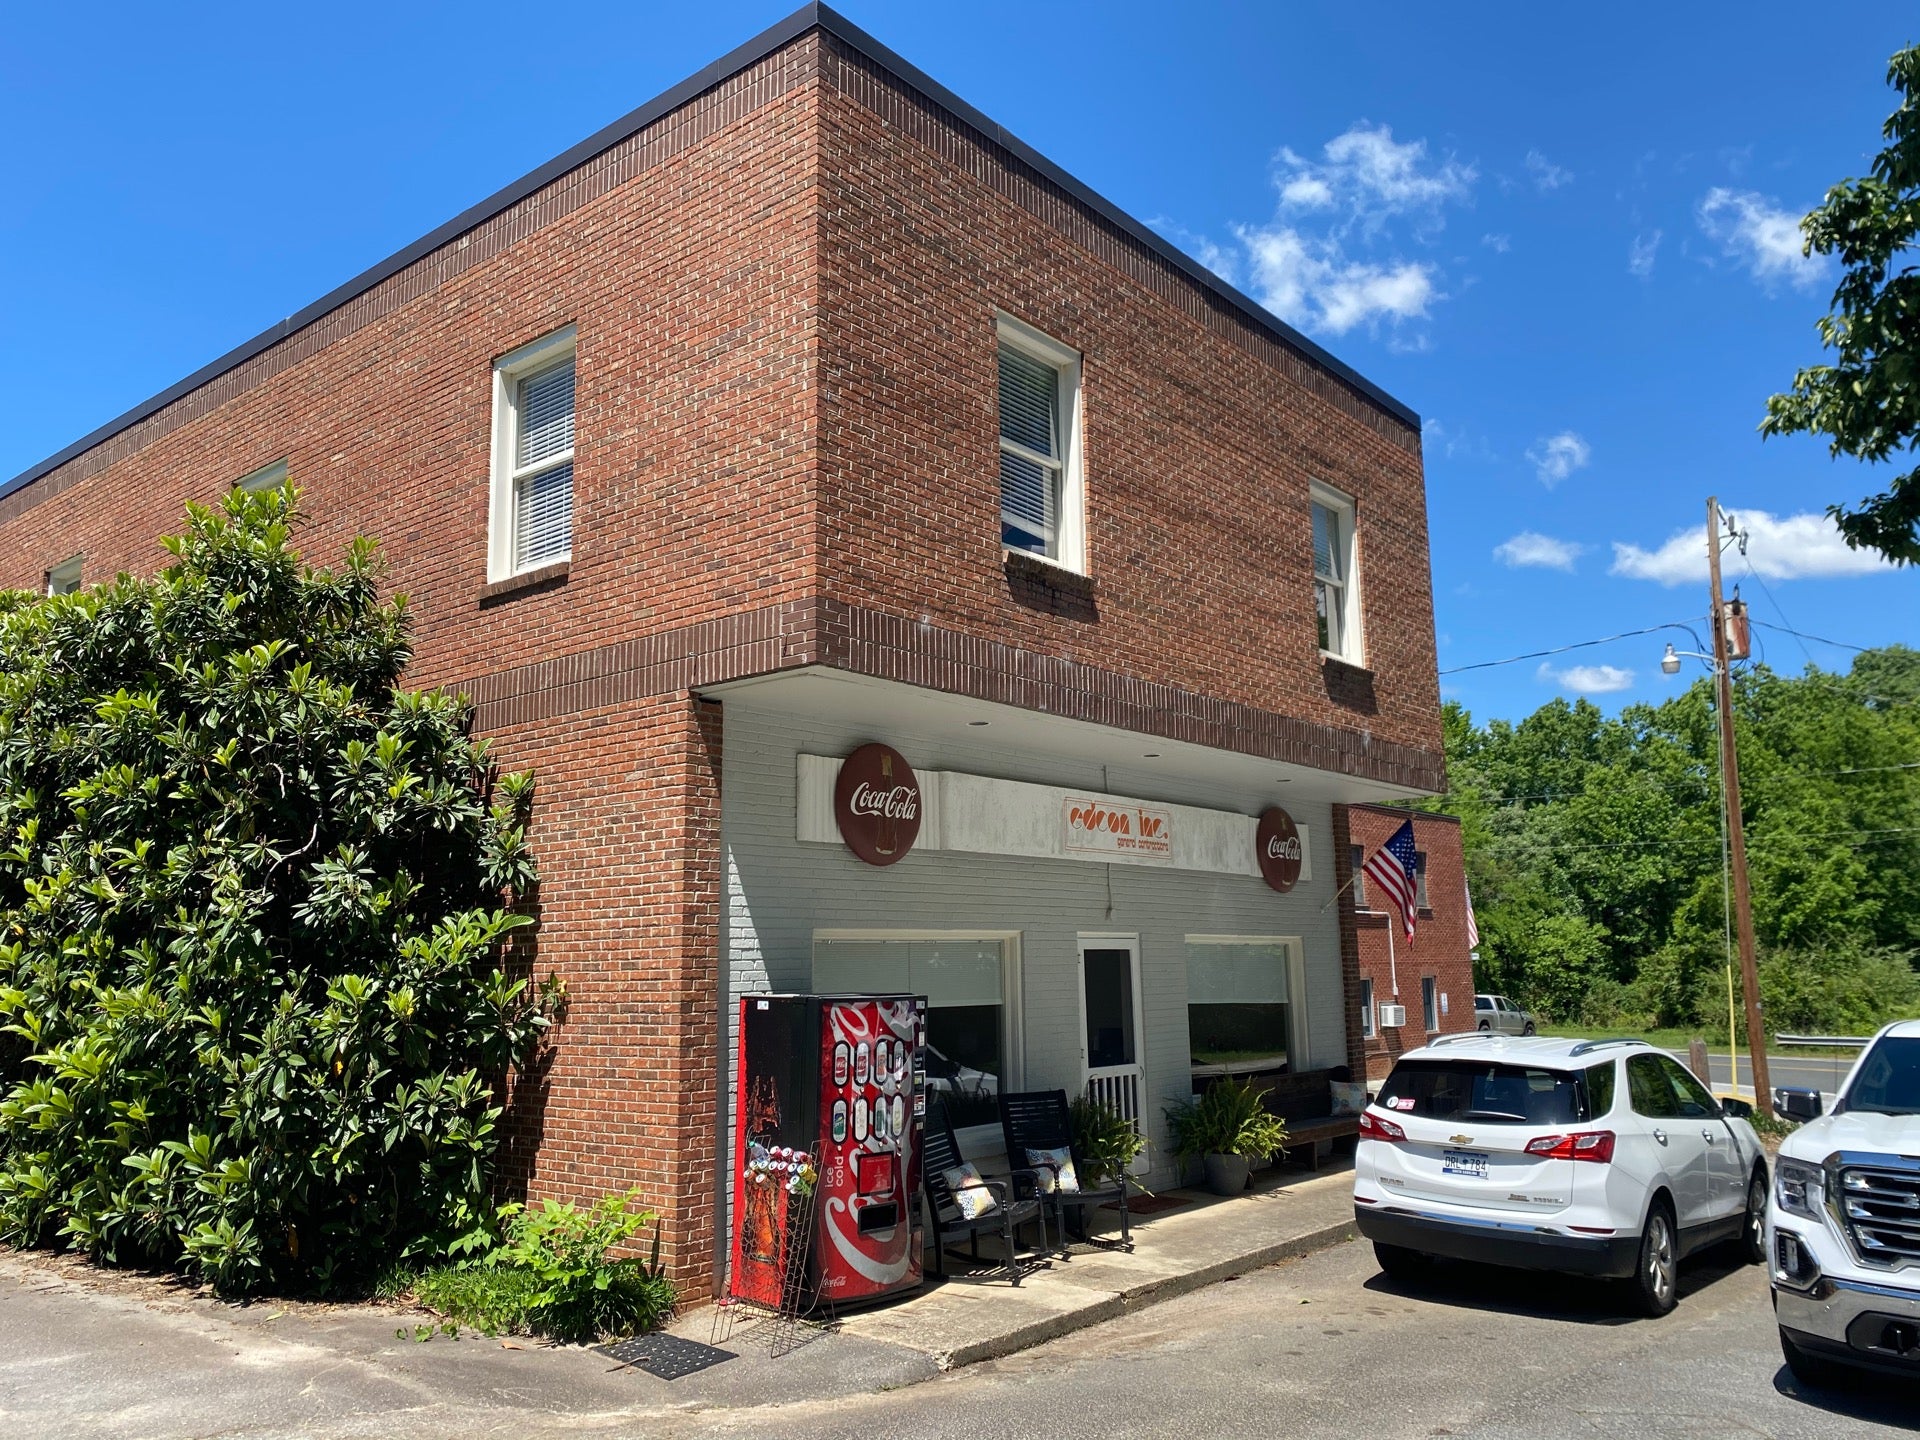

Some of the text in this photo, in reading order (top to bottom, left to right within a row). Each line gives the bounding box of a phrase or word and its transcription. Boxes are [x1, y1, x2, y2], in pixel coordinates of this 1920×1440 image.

[850, 782, 917, 820] Coca-Cola
[1070, 803, 1169, 839] edcon inc.
[825, 1167, 834, 1188] ice
[835, 1156, 844, 1187] cold
